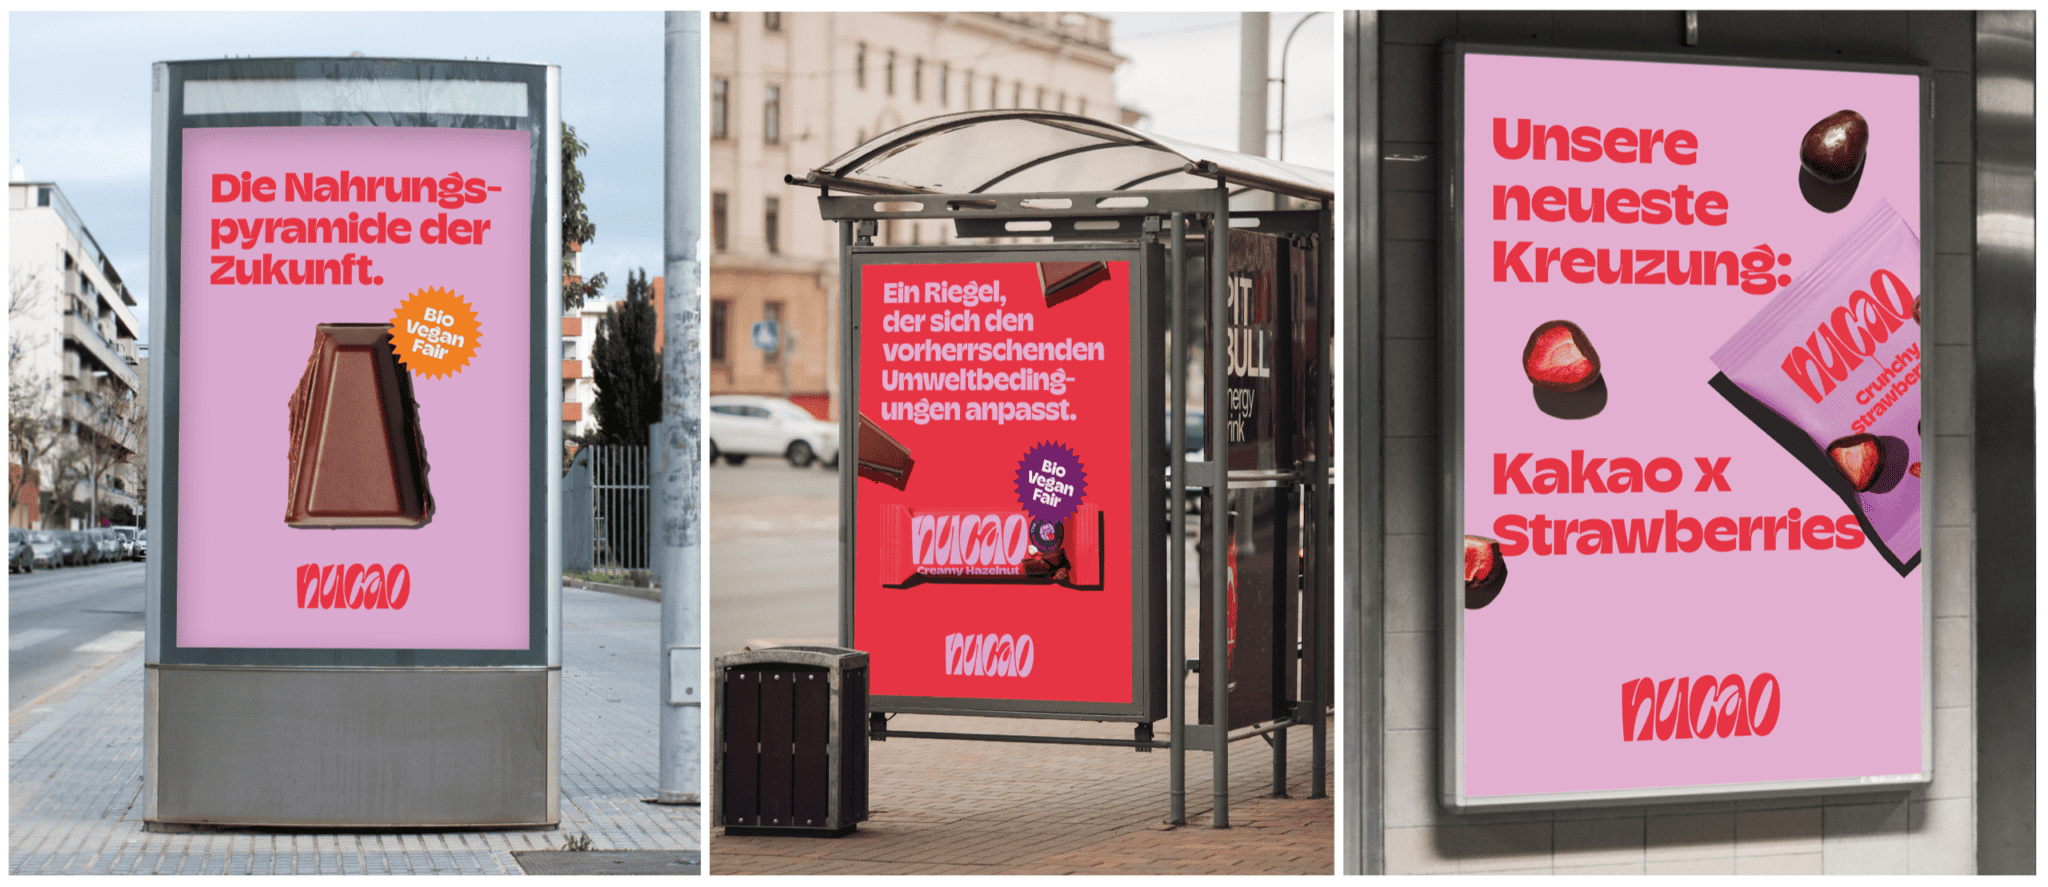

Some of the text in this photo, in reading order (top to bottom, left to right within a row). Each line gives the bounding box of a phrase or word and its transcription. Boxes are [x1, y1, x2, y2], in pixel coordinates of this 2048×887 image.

[1492, 117, 1699, 166] Unsere
[211, 171, 502, 208] Die Nahrungs-
[1493, 184, 1729, 227] neueste
[211, 212, 491, 249] pyramide der
[210, 254, 384, 286] Zukunft.
[1493, 241, 1792, 296] Kreuzung:
[884, 280, 1007, 307] Ein Riegel,
[406, 318, 465, 348] Vegan
[423, 307, 455, 328] Bio
[883, 309, 1034, 332] der sich den
[412, 338, 449, 360] Fair
[882, 338, 1105, 362] vorherrschenden
[1781, 269, 1915, 405] nucao
[882, 367, 1076, 395] Umweltbeding-
[881, 398, 1077, 425] ungen anpasst.
[1227, 387, 1255, 418] nergy
[1028, 469, 1075, 497] Vegan
[1042, 459, 1066, 478] Bio
[1493, 450, 1732, 495] Kakao x
[1032, 487, 1062, 508] Fair
[911, 514, 1028, 566] nucao
[1493, 507, 1866, 557] Strawberries
[917, 566, 1020, 576] Creamy Hazelnut
[296, 564, 411, 610] nucao
[945, 633, 1035, 678] nucao
[1621, 672, 1781, 742] nucao
